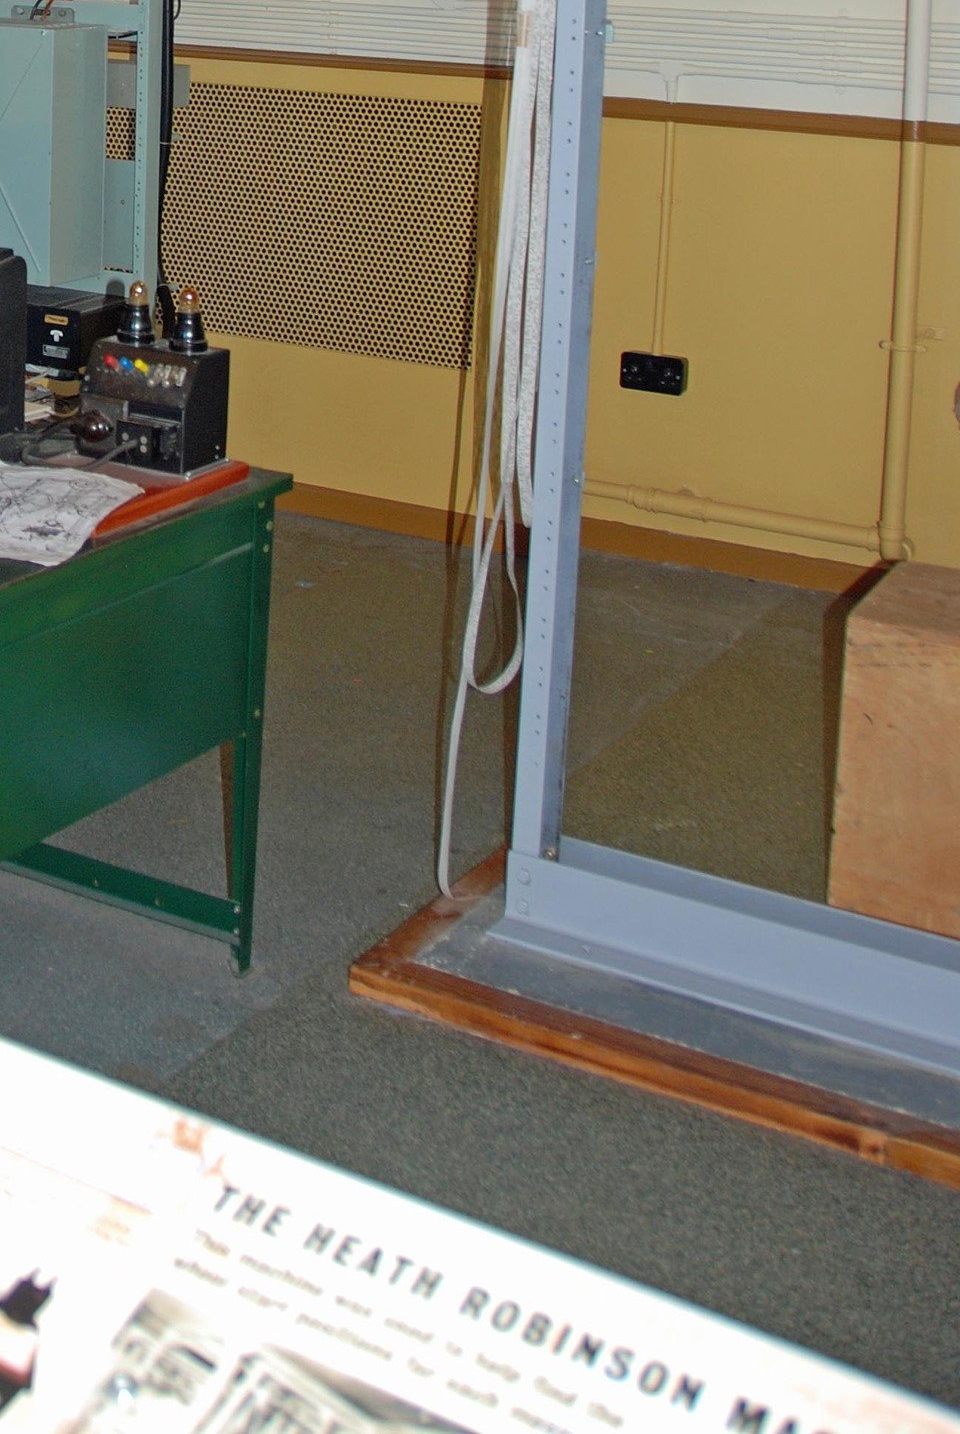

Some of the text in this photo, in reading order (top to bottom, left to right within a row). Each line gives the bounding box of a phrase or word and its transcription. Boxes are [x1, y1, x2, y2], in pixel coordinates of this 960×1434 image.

[213, 1183, 291, 1237] THE
[302, 1222, 444, 1300] HEATH
[458, 1286, 706, 1413] ROBINSON
